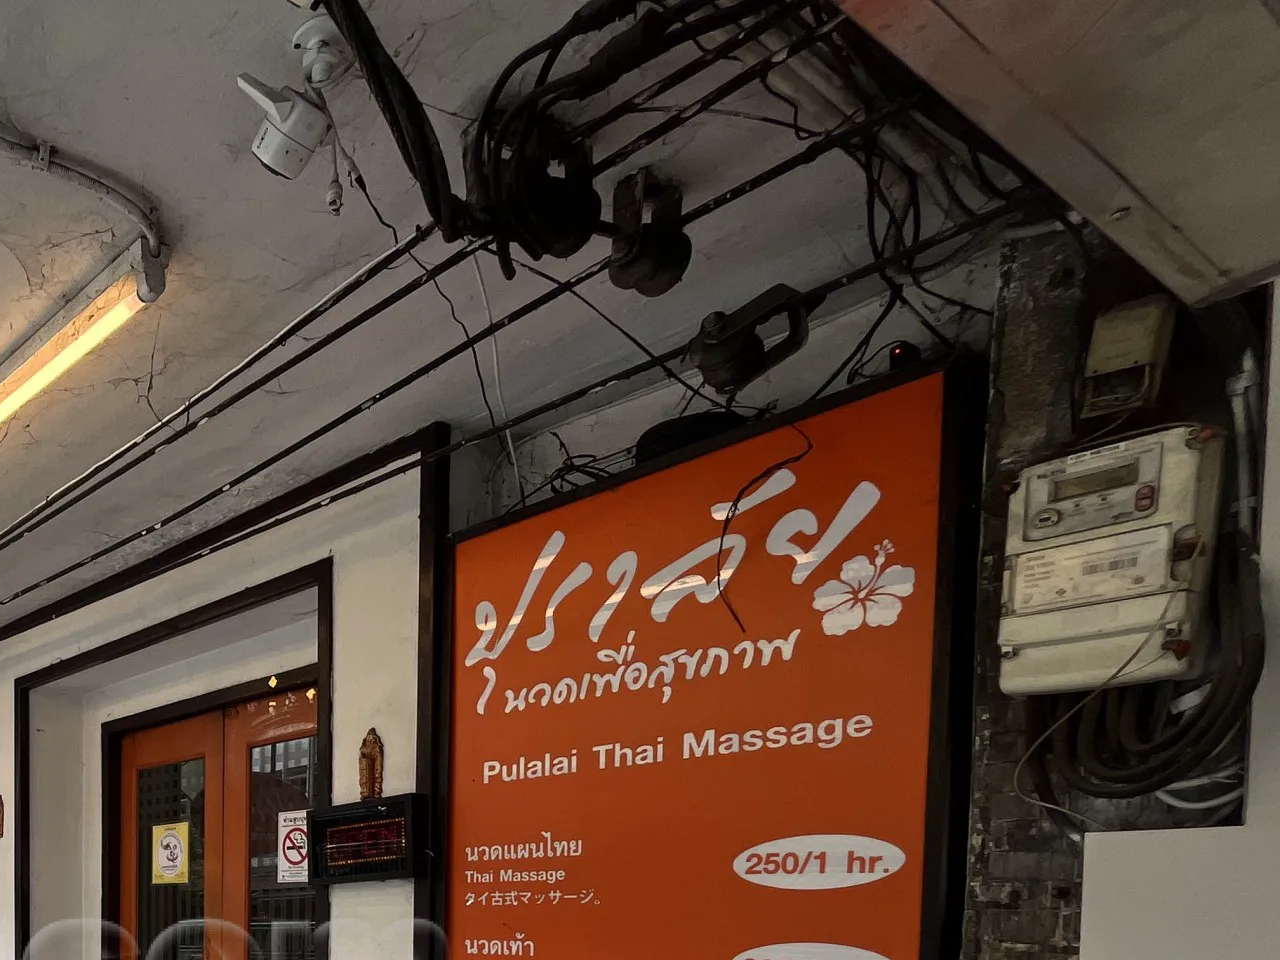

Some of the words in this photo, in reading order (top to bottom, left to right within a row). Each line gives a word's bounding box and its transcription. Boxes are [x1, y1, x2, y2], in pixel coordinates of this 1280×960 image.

[505, 630, 801, 714] นวดเพื่อสุขภาพ
[483, 749, 577, 784] Pulalai
[593, 737, 663, 770] Thai
[683, 714, 873, 761] Massage
[465, 832, 582, 862] นวดแผนไทย
[465, 869, 494, 883] Thai
[499, 868, 566, 884] Massage
[745, 851, 827, 876] 250/1
[846, 851, 890, 874] hr.
[465, 933, 535, 957] นวดเท้า
